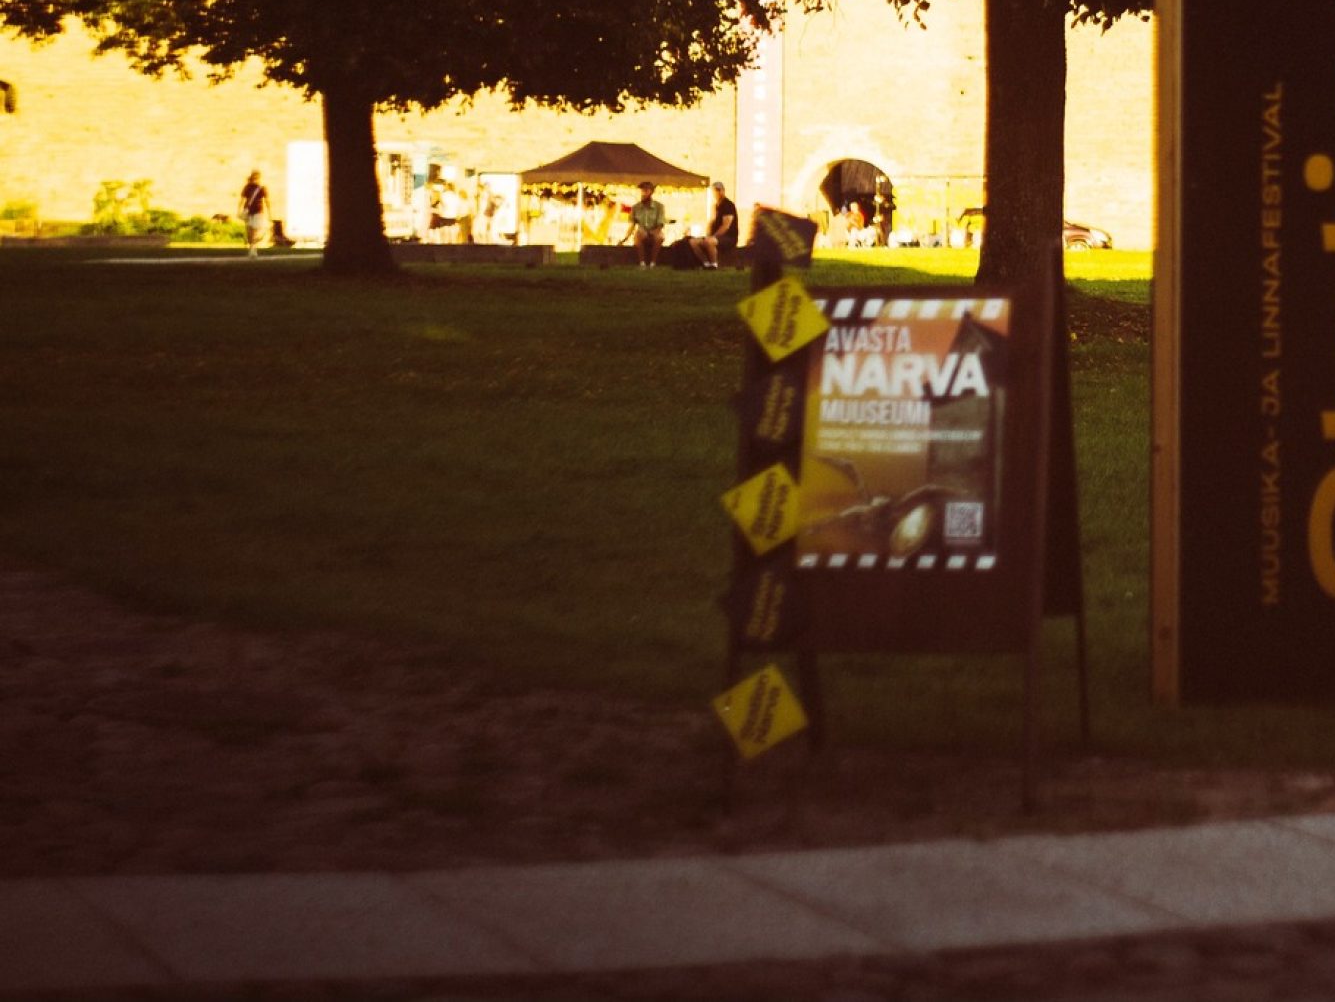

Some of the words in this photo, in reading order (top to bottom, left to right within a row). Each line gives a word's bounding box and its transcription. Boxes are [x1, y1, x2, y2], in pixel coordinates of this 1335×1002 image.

[1260, 82, 1284, 358] LINNAFESTIVAL
[824, 325, 913, 353] AVASTA
[820, 351, 989, 398] NARVA
[1260, 369, 1282, 417] JA
[819, 400, 931, 425] MUUSEUMI
[1260, 425, 1282, 605] MUUSIKA-
